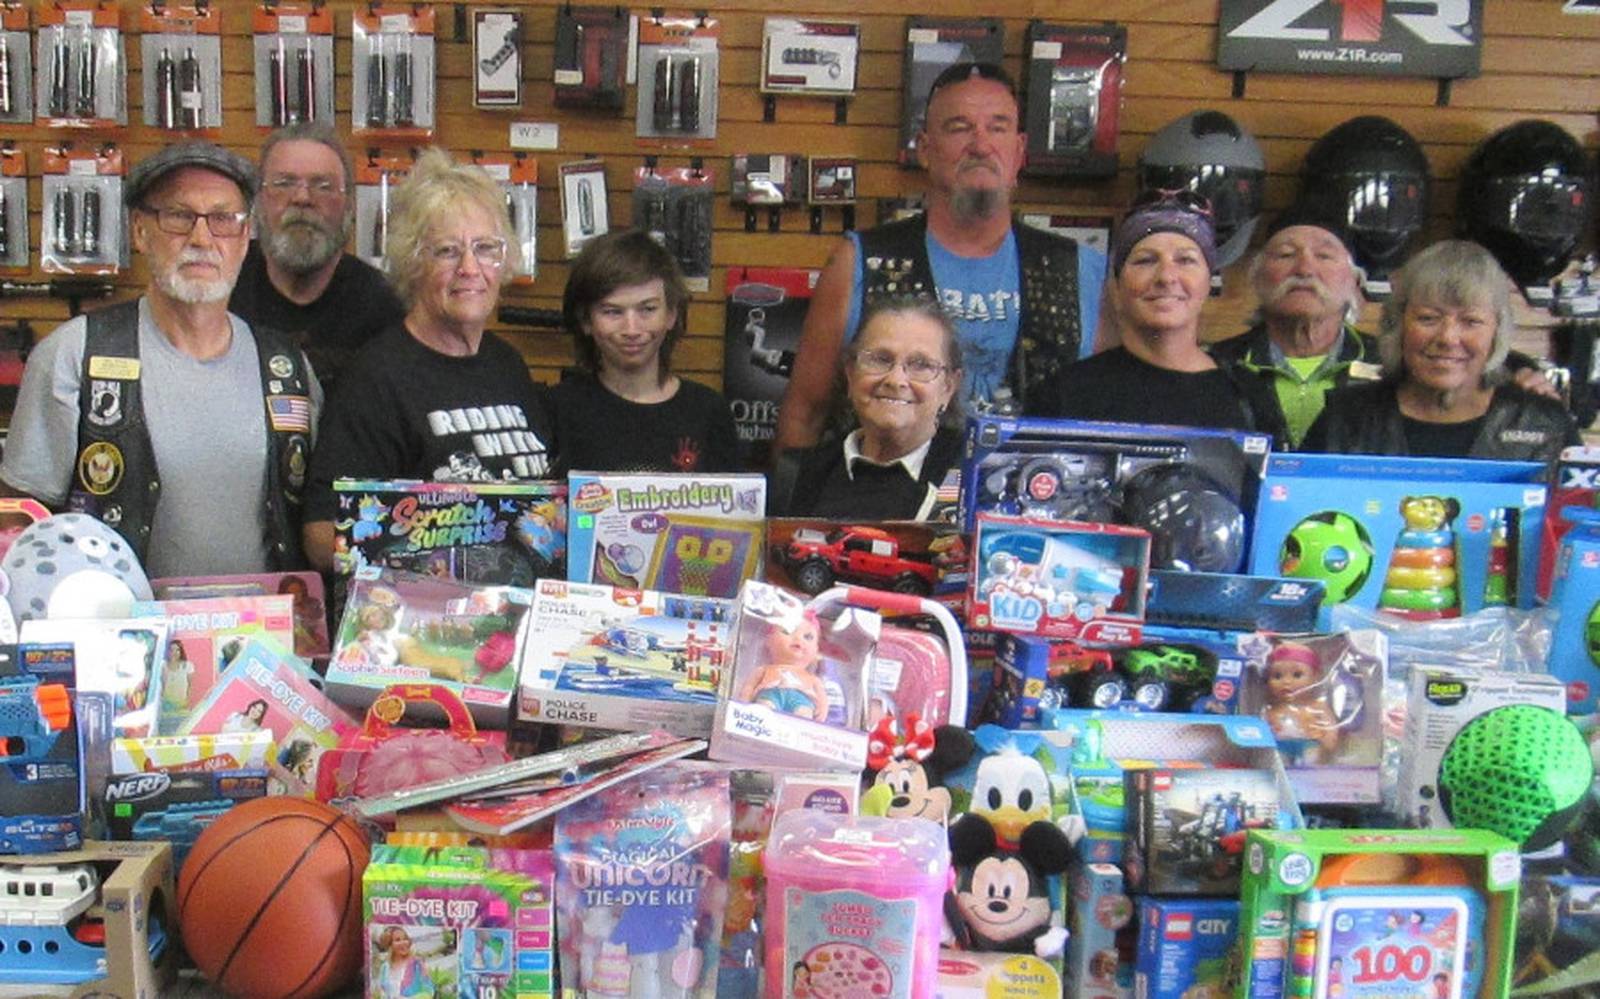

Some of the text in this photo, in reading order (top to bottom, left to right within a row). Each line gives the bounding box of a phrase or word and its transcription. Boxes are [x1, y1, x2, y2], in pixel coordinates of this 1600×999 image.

[1298, 48, 1403, 64] www.Z1R.com
[617, 481, 734, 513] Embroidery
[390, 497, 496, 535] Scratch
[407, 521, 508, 551] SURPRISE
[538, 606, 587, 618] CHASE
[993, 595, 1040, 620] KID
[245, 658, 304, 712] TIE-DYE
[545, 700, 586, 711] POLICE
[545, 710, 598, 722] CHASE
[733, 708, 764, 724] Baby
[735, 720, 772, 737] Magic
[26, 763, 38, 780] 3
[105, 775, 164, 801] NERF
[585, 888, 696, 906] TIE-DYE KIT
[370, 897, 478, 918] TIE-DYE KIT
[1197, 919, 1231, 935] CITY
[1351, 945, 1432, 984] 100
